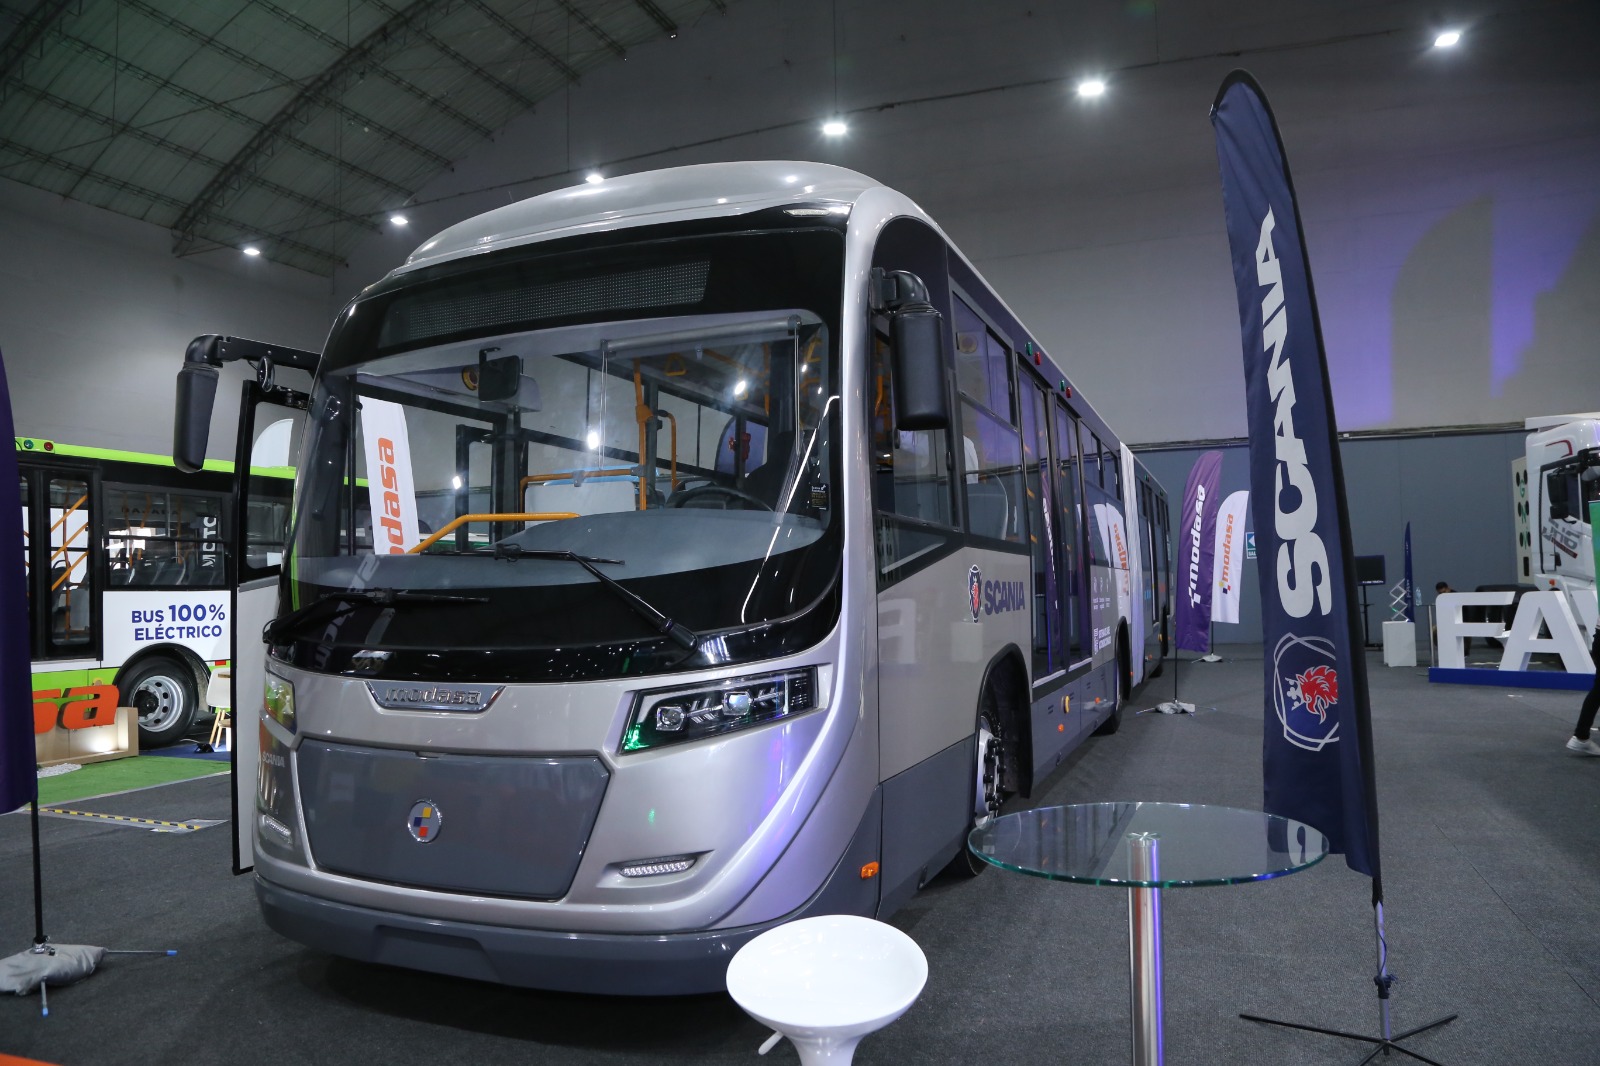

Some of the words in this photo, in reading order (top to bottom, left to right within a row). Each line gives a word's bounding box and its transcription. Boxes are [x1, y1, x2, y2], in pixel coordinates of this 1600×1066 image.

[1255, 203, 1332, 619] SCANIA
[1188, 484, 1206, 591] modasa
[1221, 513, 1234, 583] modasa
[984, 580, 1025, 616] SCANIA
[131, 610, 165, 624] BUS
[168, 604, 226, 622] 100%
[134, 623, 223, 641] ELÉCTRICO
[385, 687, 482, 705] modasa
[262, 751, 286, 768] SCANIA
